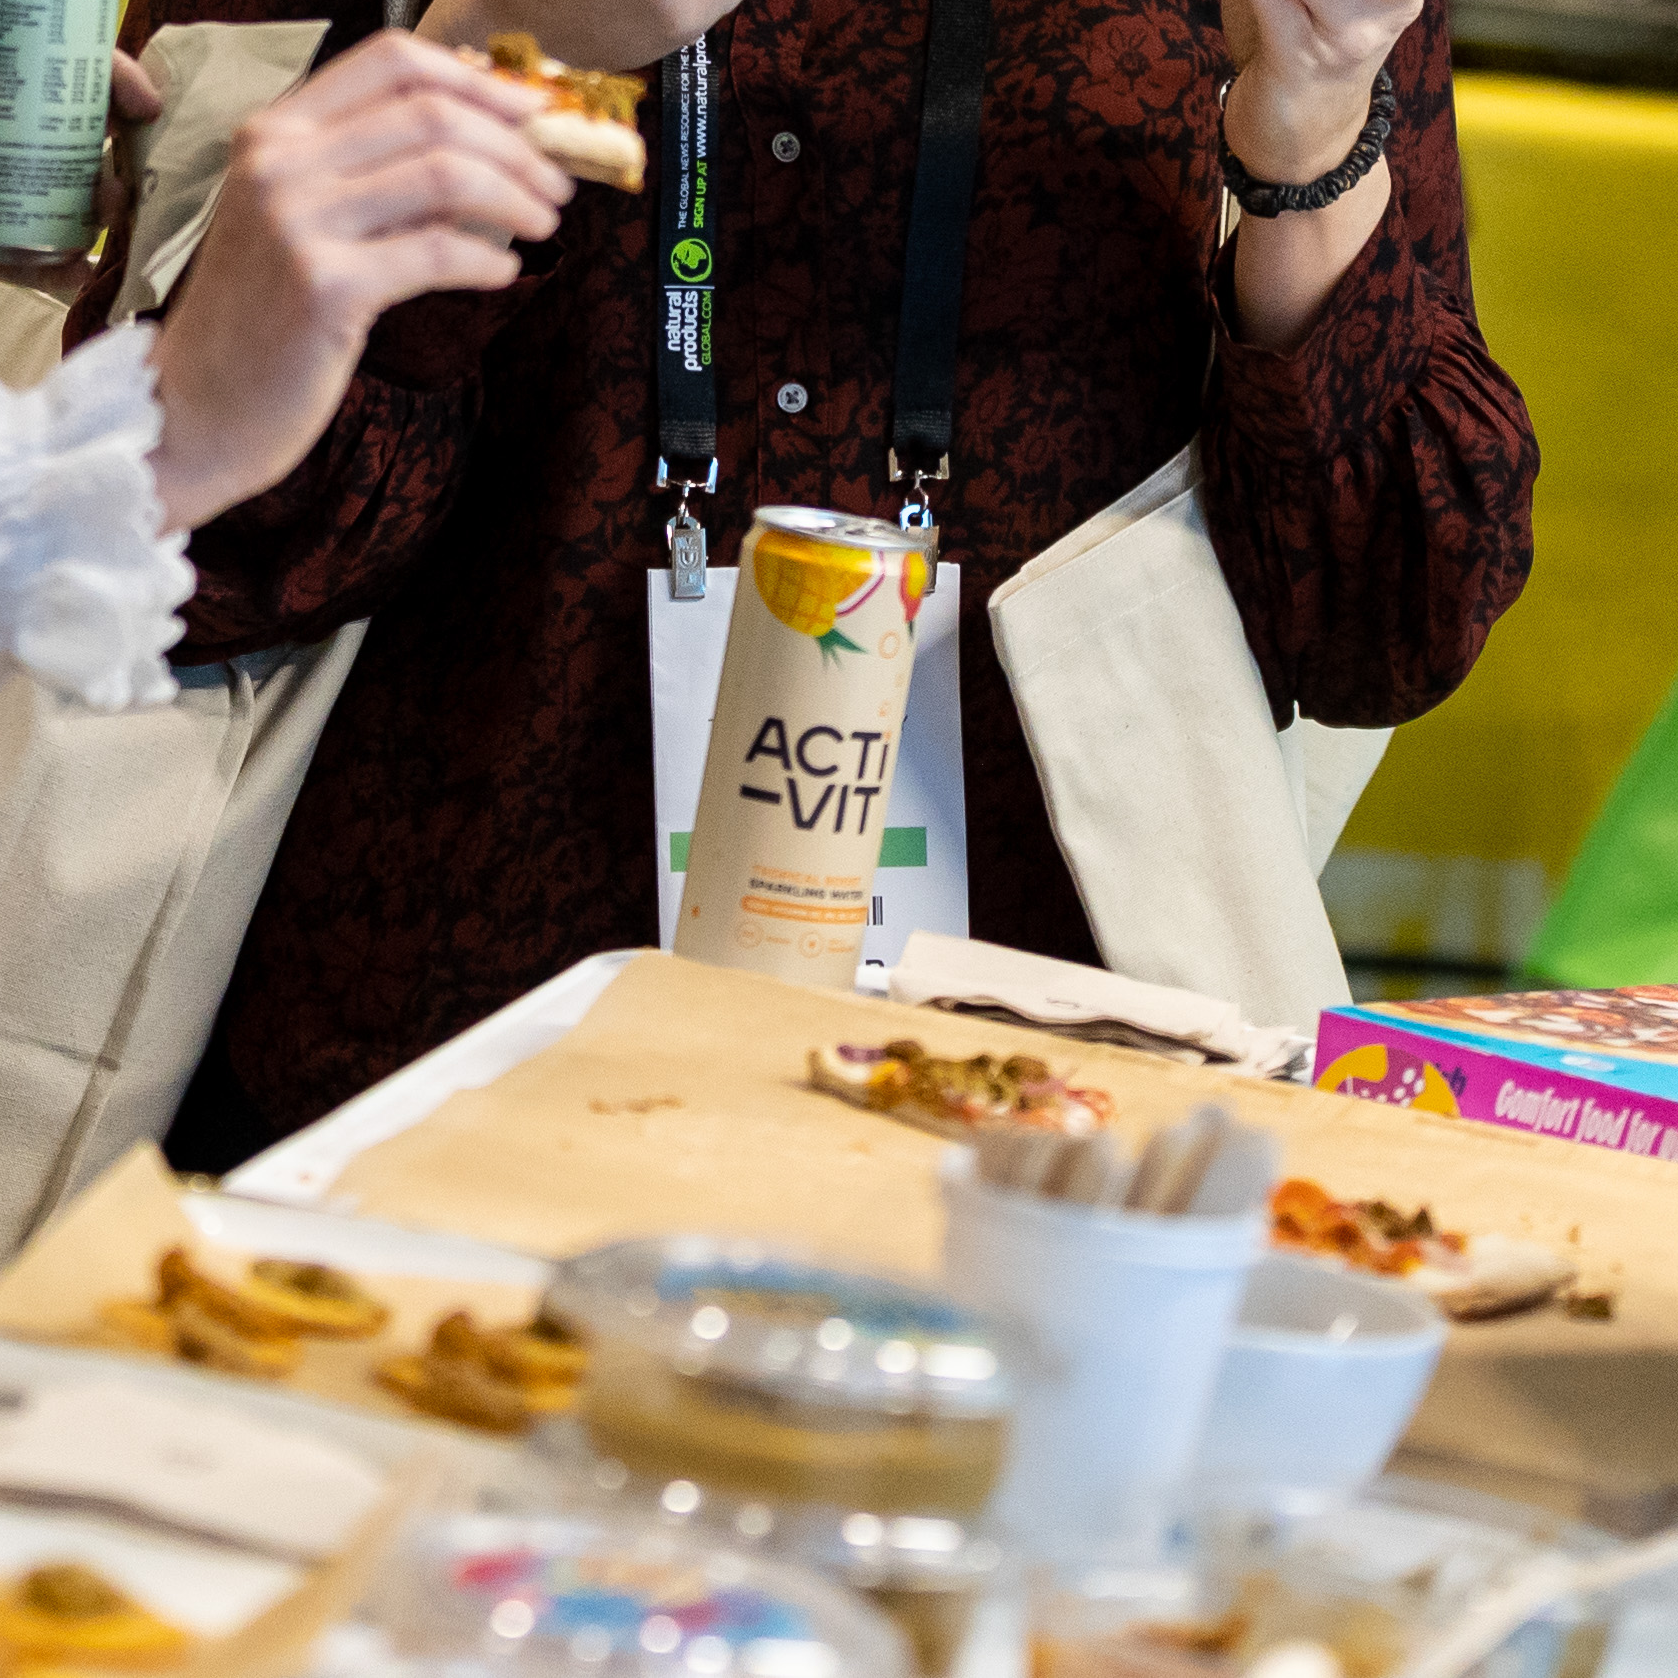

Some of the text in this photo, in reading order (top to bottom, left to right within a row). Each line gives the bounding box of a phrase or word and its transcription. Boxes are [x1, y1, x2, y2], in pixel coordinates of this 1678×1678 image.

[680, 54, 690, 70] THE
[680, 72, 690, 91] FOR
[680, 93, 690, 141] RESOURCE
[680, 142, 690, 171] NEWS
[696, 159, 708, 177] AT
[680, 172, 690, 210] GLOBAL
[695, 176, 708, 195] UP
[677, 211, 688, 229] THE
[693, 197, 706, 228] SIGN
[665, 291, 683, 352] natural
[681, 290, 703, 372] products
[1494, 1078, 1582, 1134] Comfort
[1573, 1097, 1630, 1146] food
[1624, 1108, 1664, 1156] for
